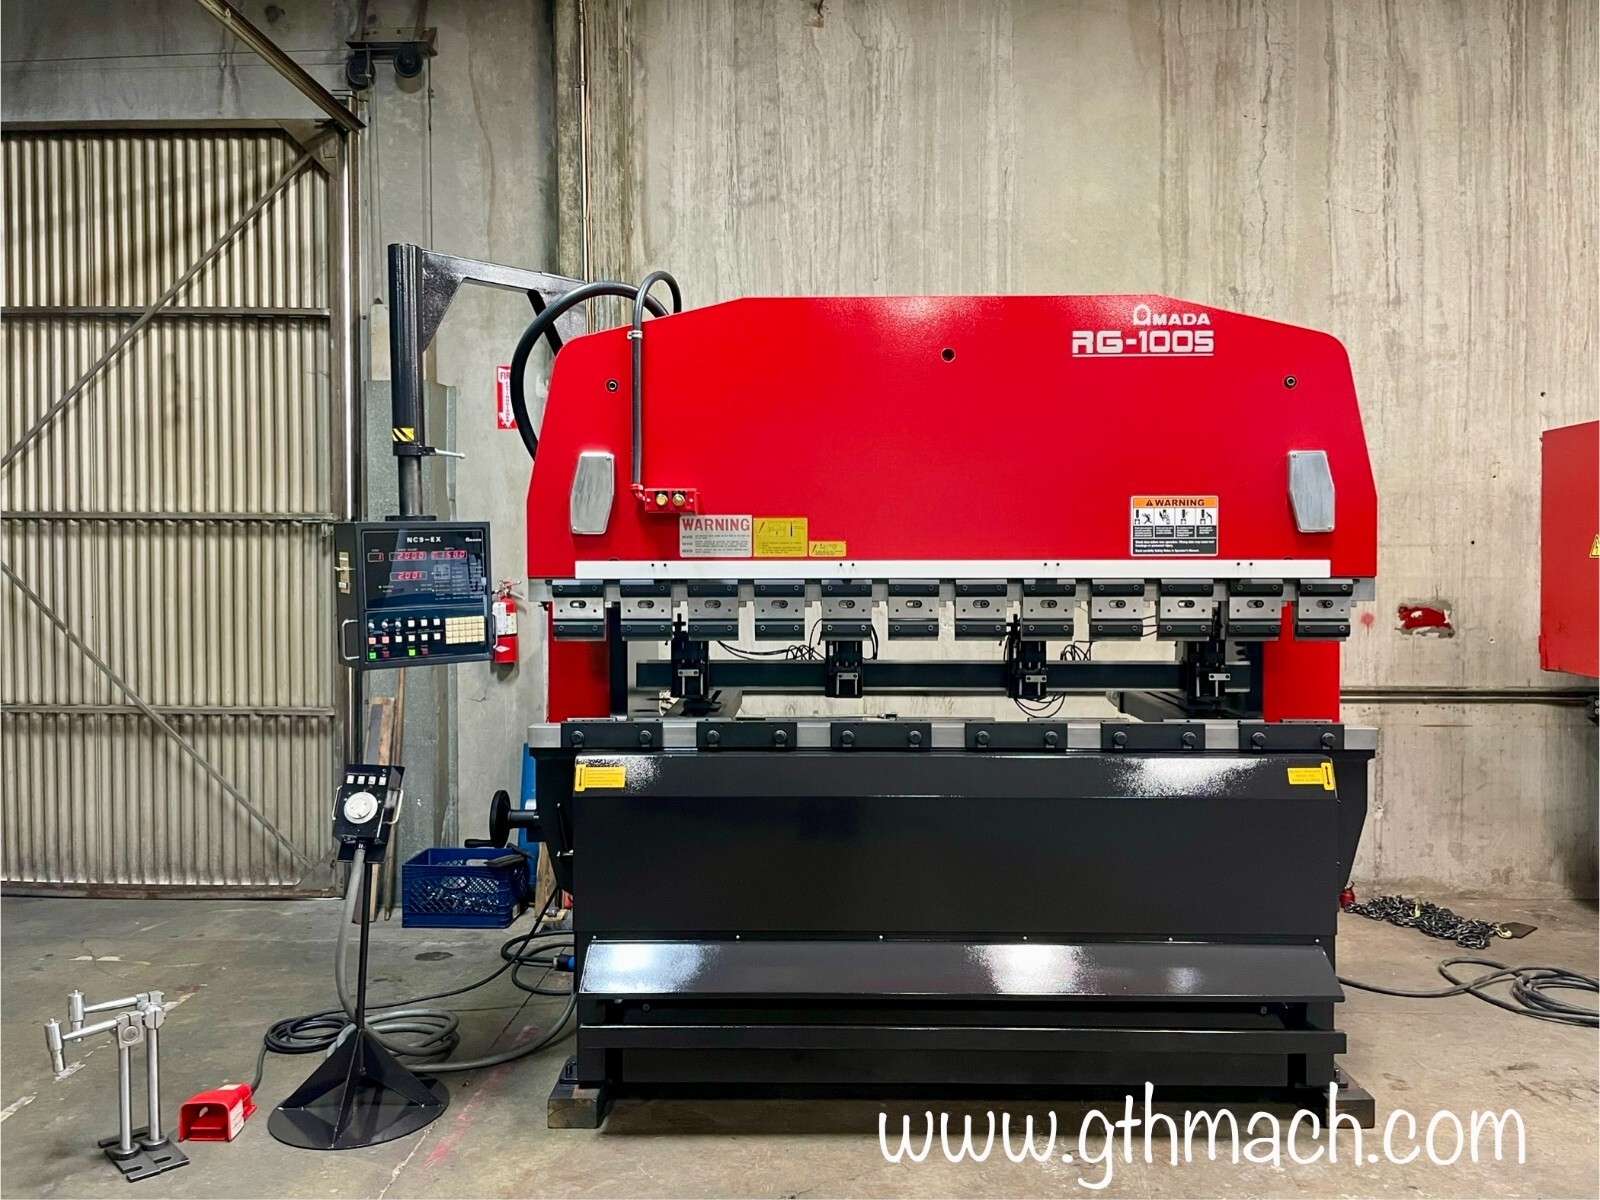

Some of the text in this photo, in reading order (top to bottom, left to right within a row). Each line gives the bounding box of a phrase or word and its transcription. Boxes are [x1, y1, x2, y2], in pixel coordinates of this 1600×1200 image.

[1133, 304, 1211, 325] AMADA
[1072, 330, 1214, 354] RG-100S
[500, 372, 511, 380] FIR
[1154, 499, 1205, 507] WARNING
[682, 518, 750, 531] WARNING
